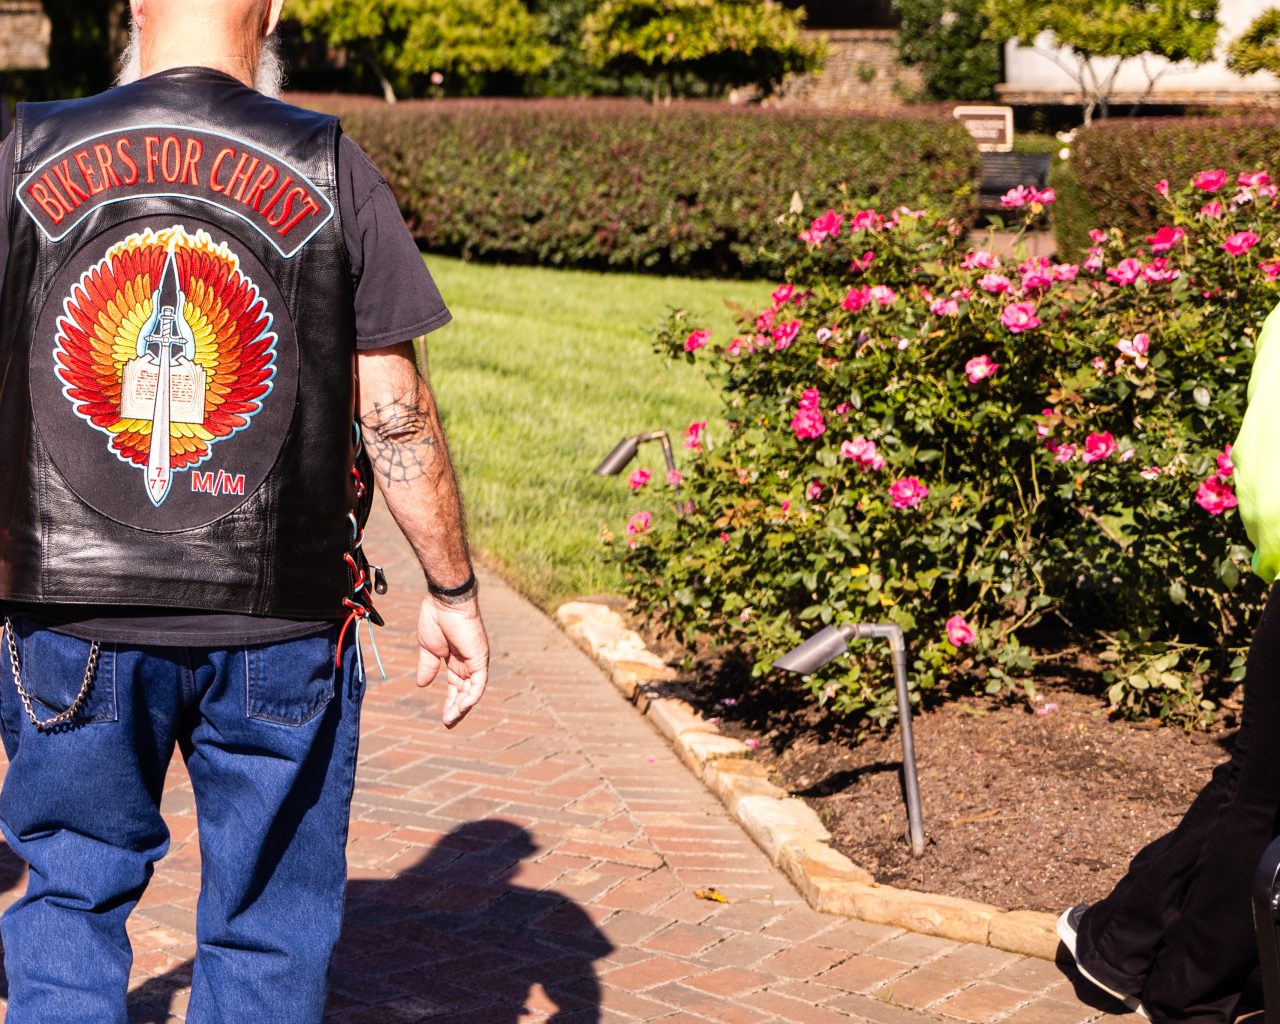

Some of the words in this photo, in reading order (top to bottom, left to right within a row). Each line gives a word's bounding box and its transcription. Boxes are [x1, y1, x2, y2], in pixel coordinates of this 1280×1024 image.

[26, 136, 140, 226] BIKERS
[145, 135, 204, 186] FOR
[210, 147, 322, 238] CHRIST
[191, 469, 246, 496] M/M
